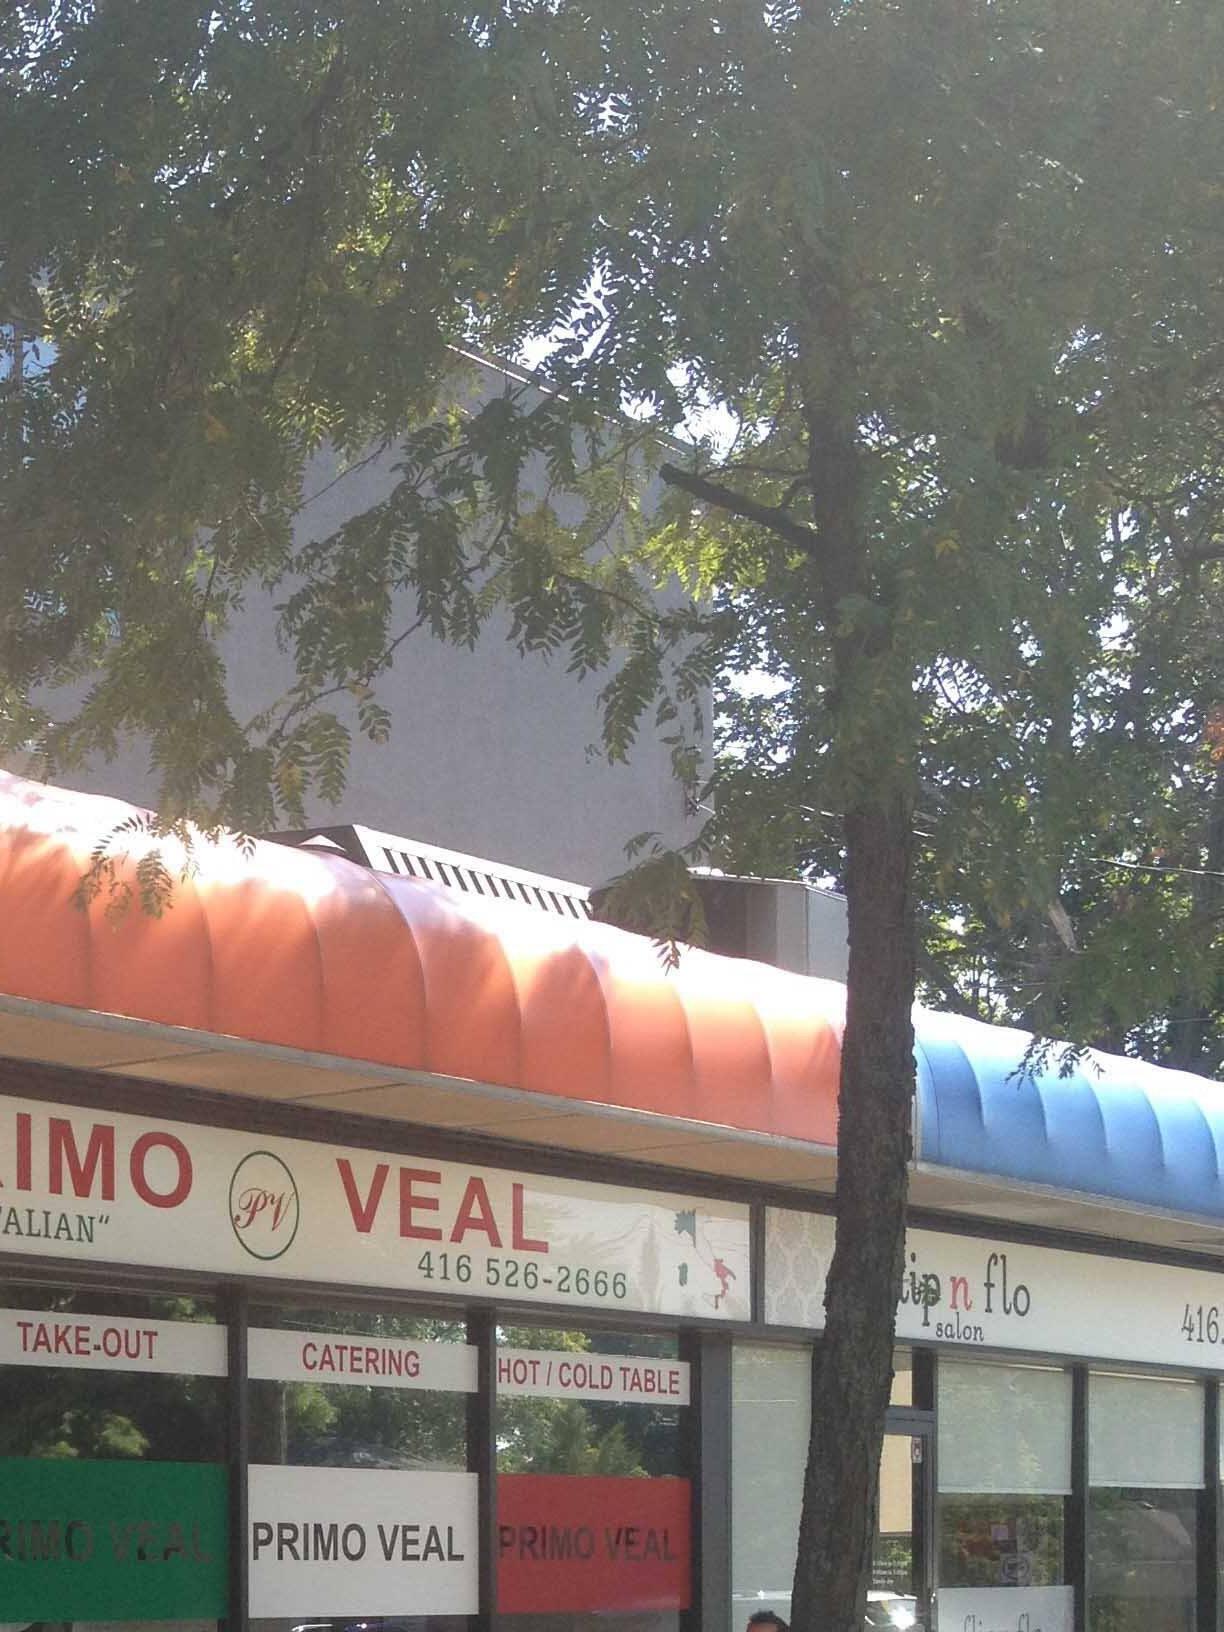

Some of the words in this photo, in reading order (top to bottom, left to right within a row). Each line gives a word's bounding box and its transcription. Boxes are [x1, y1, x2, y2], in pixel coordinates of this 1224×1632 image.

[335, 1158, 550, 1254] VEAL
[417, 1250, 472, 1283] 416
[486, 1257, 628, 1299] 526-2666
[949, 1275, 973, 1311] n
[984, 1252, 1031, 1317] flo
[16, 1321, 159, 1359] TAKE-OUT
[936, 1312, 985, 1342] salon
[301, 1341, 421, 1377] CATERING
[497, 1358, 541, 1386] HOT
[558, 1362, 613, 1390] COLD
[619, 1366, 681, 1395] TABLE
[107, 1519, 213, 1561] VEAL
[252, 1521, 367, 1561] PRIMO
[376, 1524, 465, 1562] VEAL
[498, 1524, 595, 1561] PRIMO
[604, 1525, 679, 1562] VEAL
